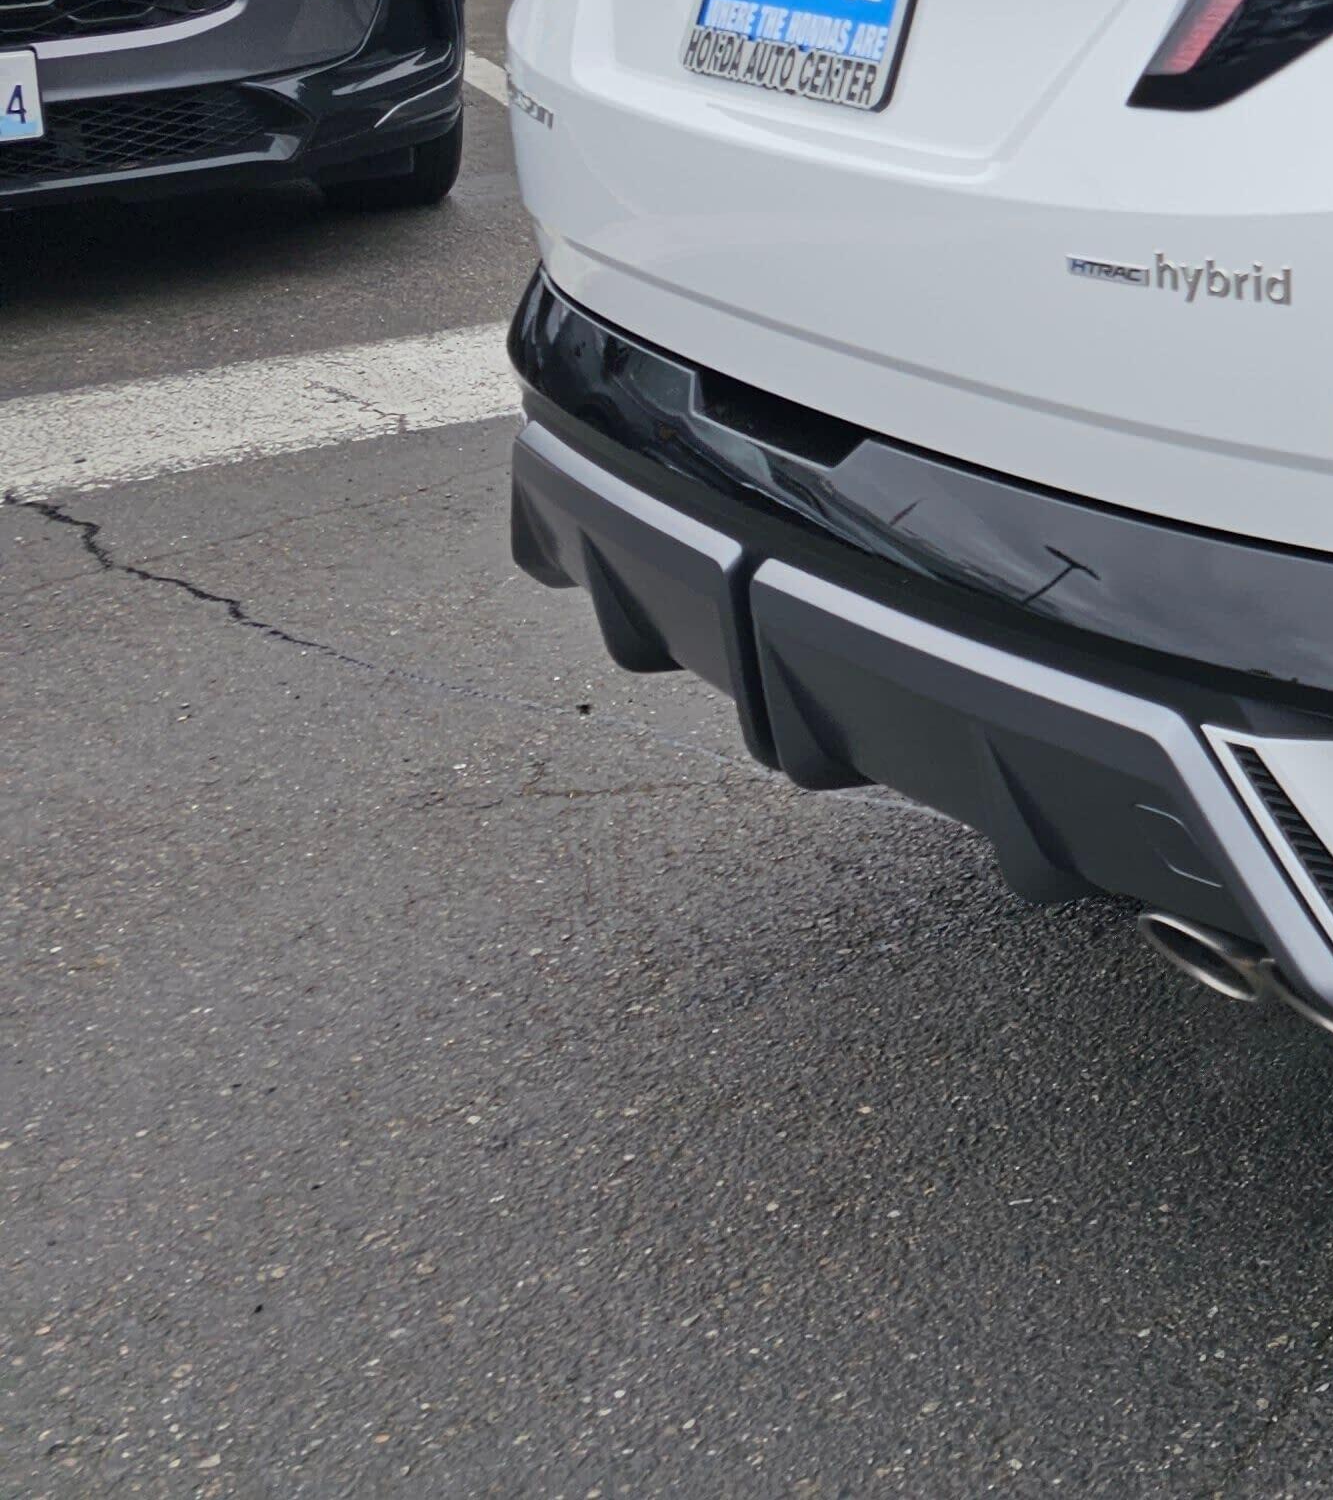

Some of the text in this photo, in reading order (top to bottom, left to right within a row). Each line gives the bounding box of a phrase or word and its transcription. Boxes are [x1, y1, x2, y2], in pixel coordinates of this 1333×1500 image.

[756, 6, 789, 39] THE
[850, 23, 889, 63] ARE
[683, 28, 877, 105] HONDA AUTO CENTER
[1068, 249, 1292, 306] HTRAC hybrid
